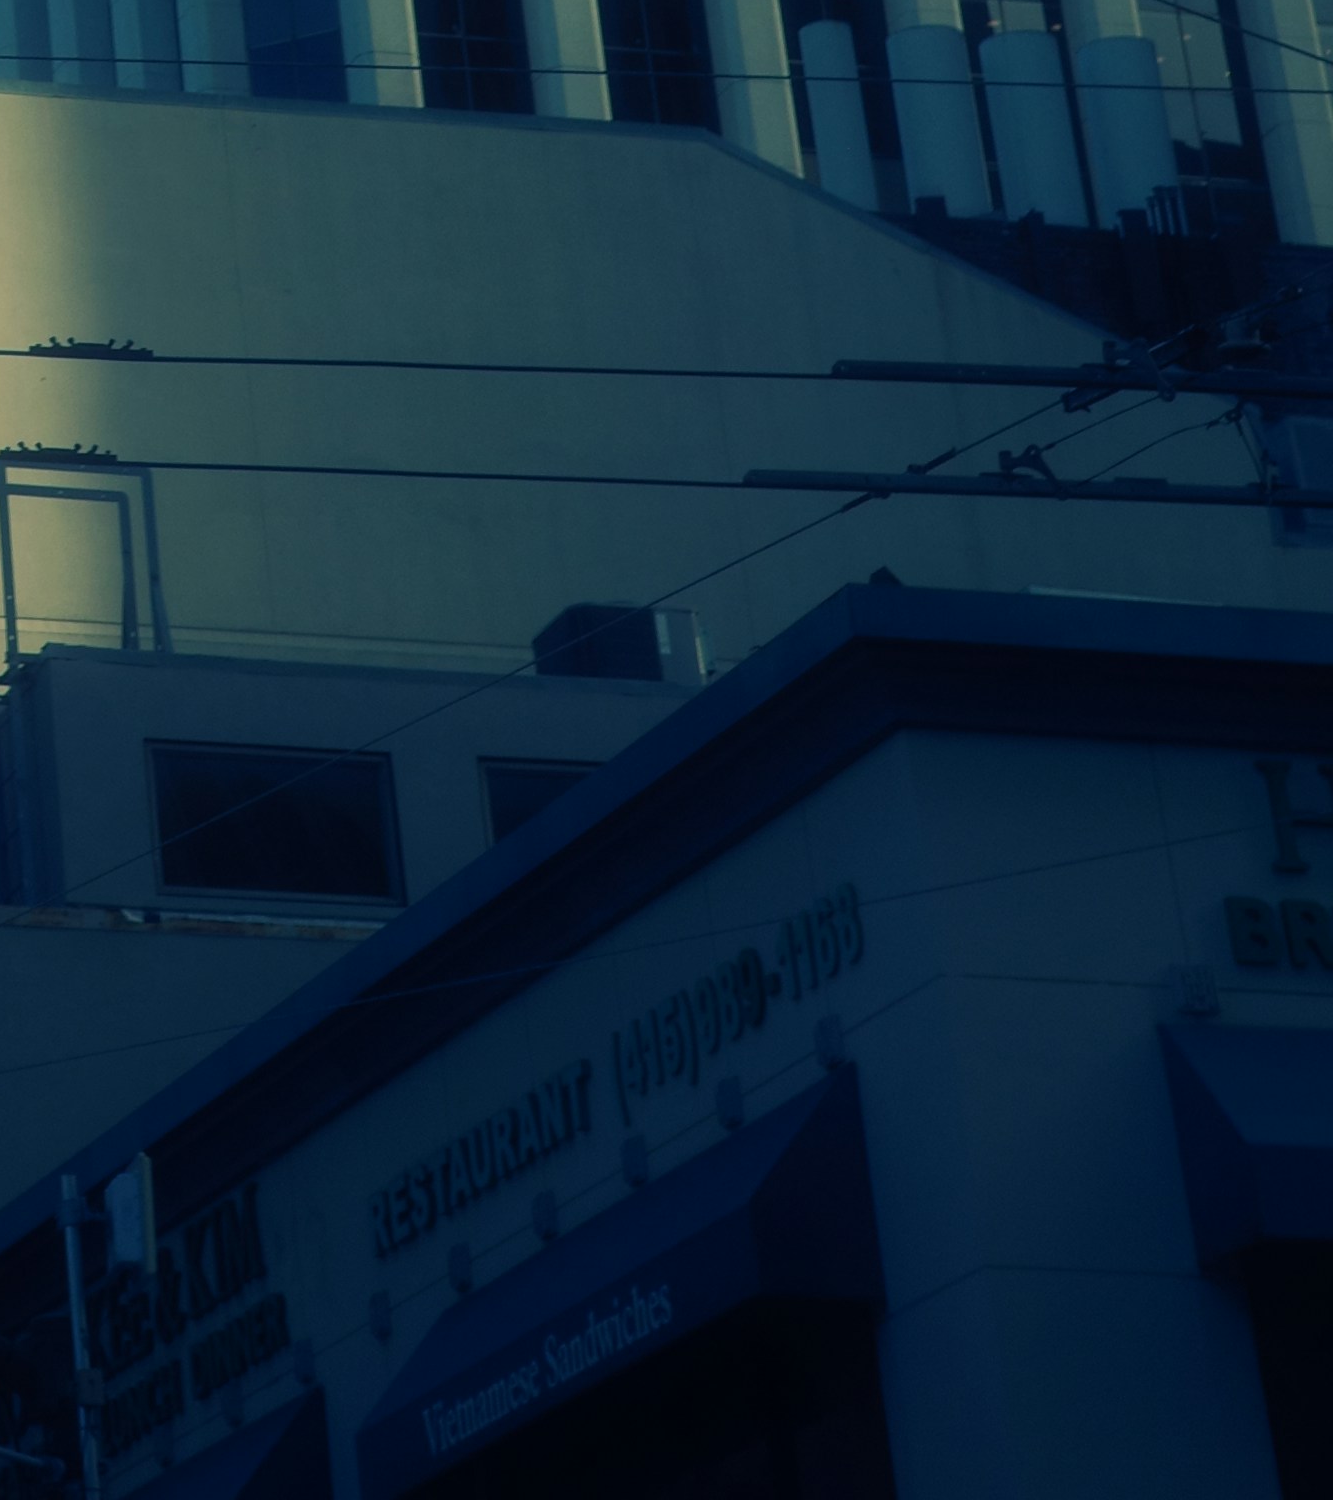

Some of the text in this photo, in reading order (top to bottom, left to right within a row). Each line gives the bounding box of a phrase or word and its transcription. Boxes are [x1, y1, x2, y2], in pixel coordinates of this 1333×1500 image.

[367, 1057, 594, 1261] RESTAURANT
[96, 1358, 185, 1460] UNCH
[189, 1291, 291, 1401] DINNER
[422, 1283, 674, 1456] Vietnamese Sandwiches
